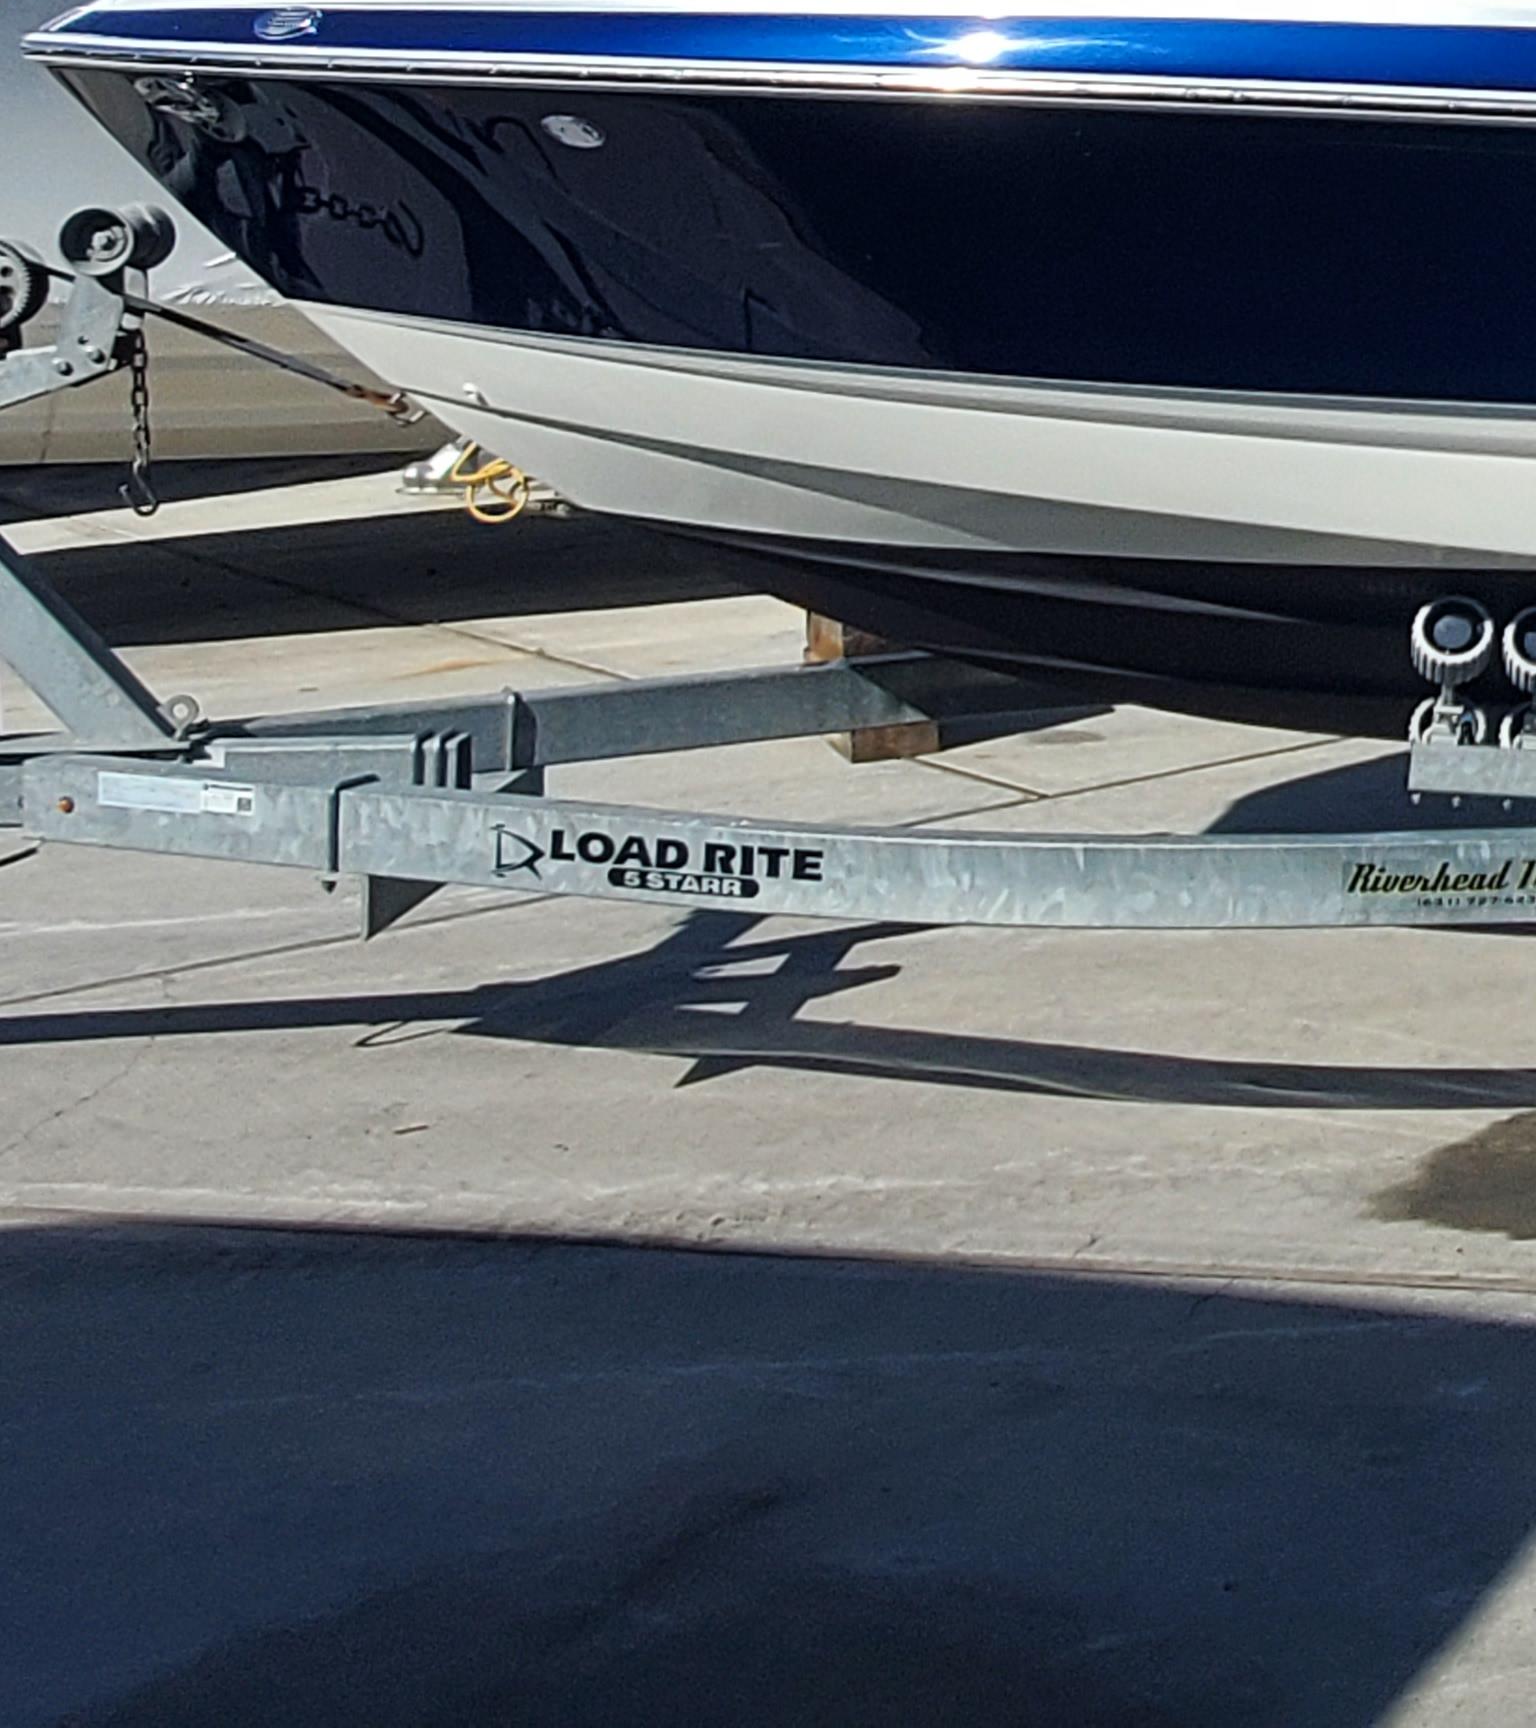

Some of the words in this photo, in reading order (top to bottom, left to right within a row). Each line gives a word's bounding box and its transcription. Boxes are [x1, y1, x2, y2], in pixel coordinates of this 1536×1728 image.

[549, 829, 689, 869] LOAD
[703, 842, 824, 881] RITE
[623, 871, 640, 889] 5
[643, 873, 743, 897] STARR
[1347, 858, 1511, 894] Riverhead
